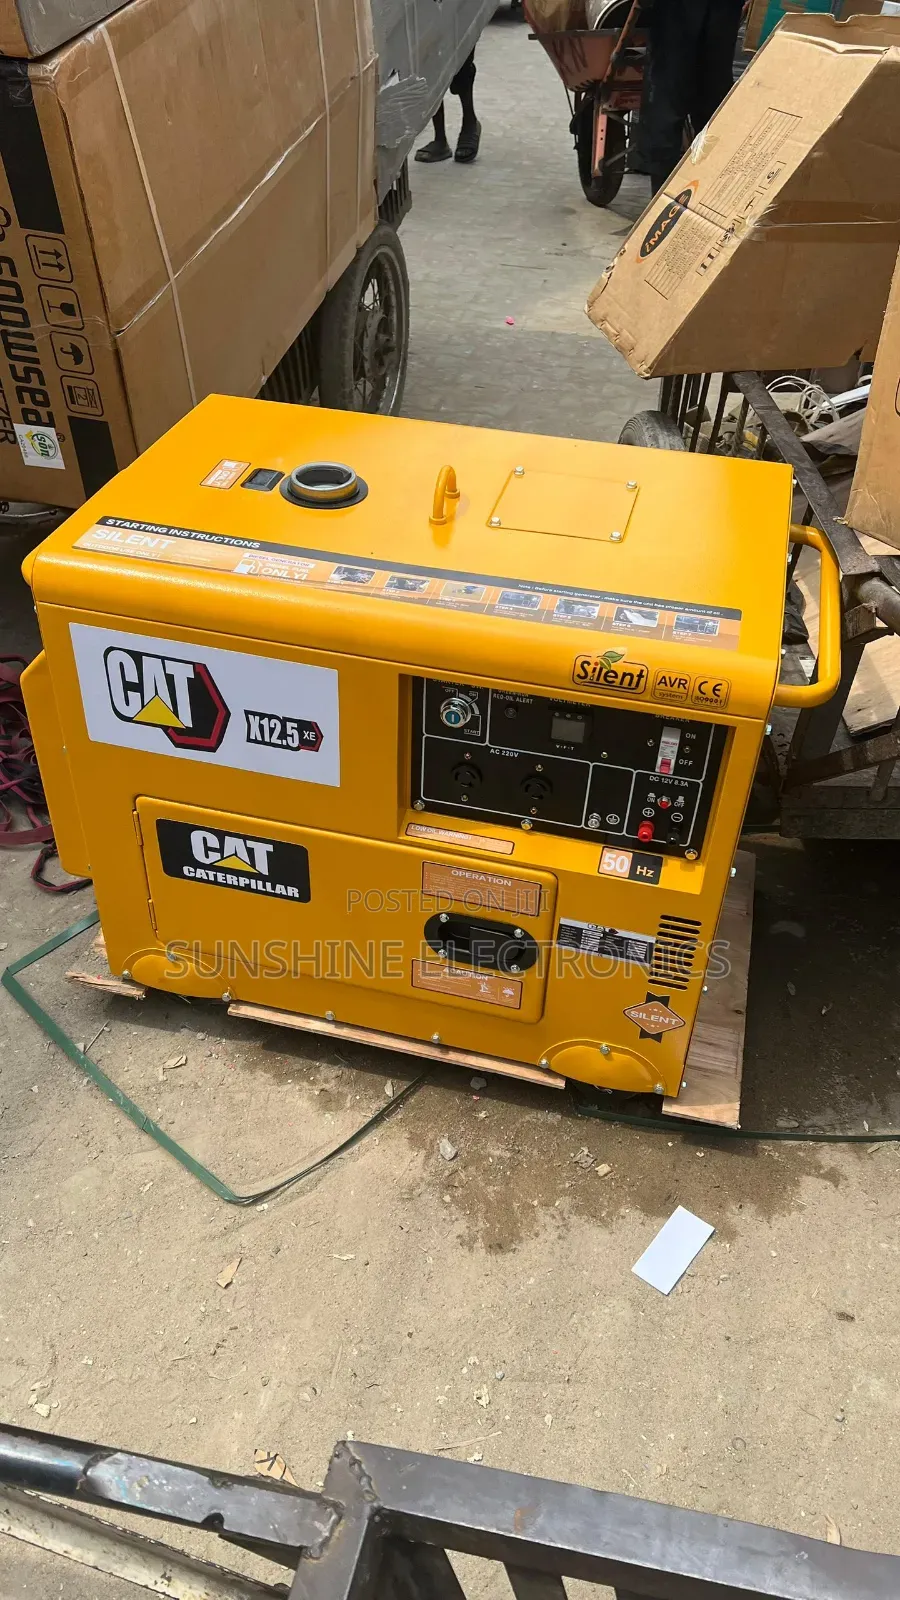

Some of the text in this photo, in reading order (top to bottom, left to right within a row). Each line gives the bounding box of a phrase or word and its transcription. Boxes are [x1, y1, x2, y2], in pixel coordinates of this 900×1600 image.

[92, 529, 177, 549] SILENT
[105, 518, 260, 549] STARTING INSTRUCTIONS
[576, 659, 645, 688] Silent
[658, 675, 688, 690] AVR
[106, 649, 195, 729] CAT
[658, 692, 683, 700] system
[698, 680, 723, 697] CE
[249, 714, 316, 748] X12.5 XE
[685, 732, 697, 740] ON
[501, 750, 519, 758] 220V
[678, 758, 693, 767] OFF
[190, 829, 274, 876] CAT
[602, 853, 655, 878] 50 Hz
[183, 865, 300, 898] CATERPILLAR
[451, 869, 512, 887] OPERATION
[450, 967, 489, 981] CAUTION
[630, 1010, 679, 1026] SILENT
